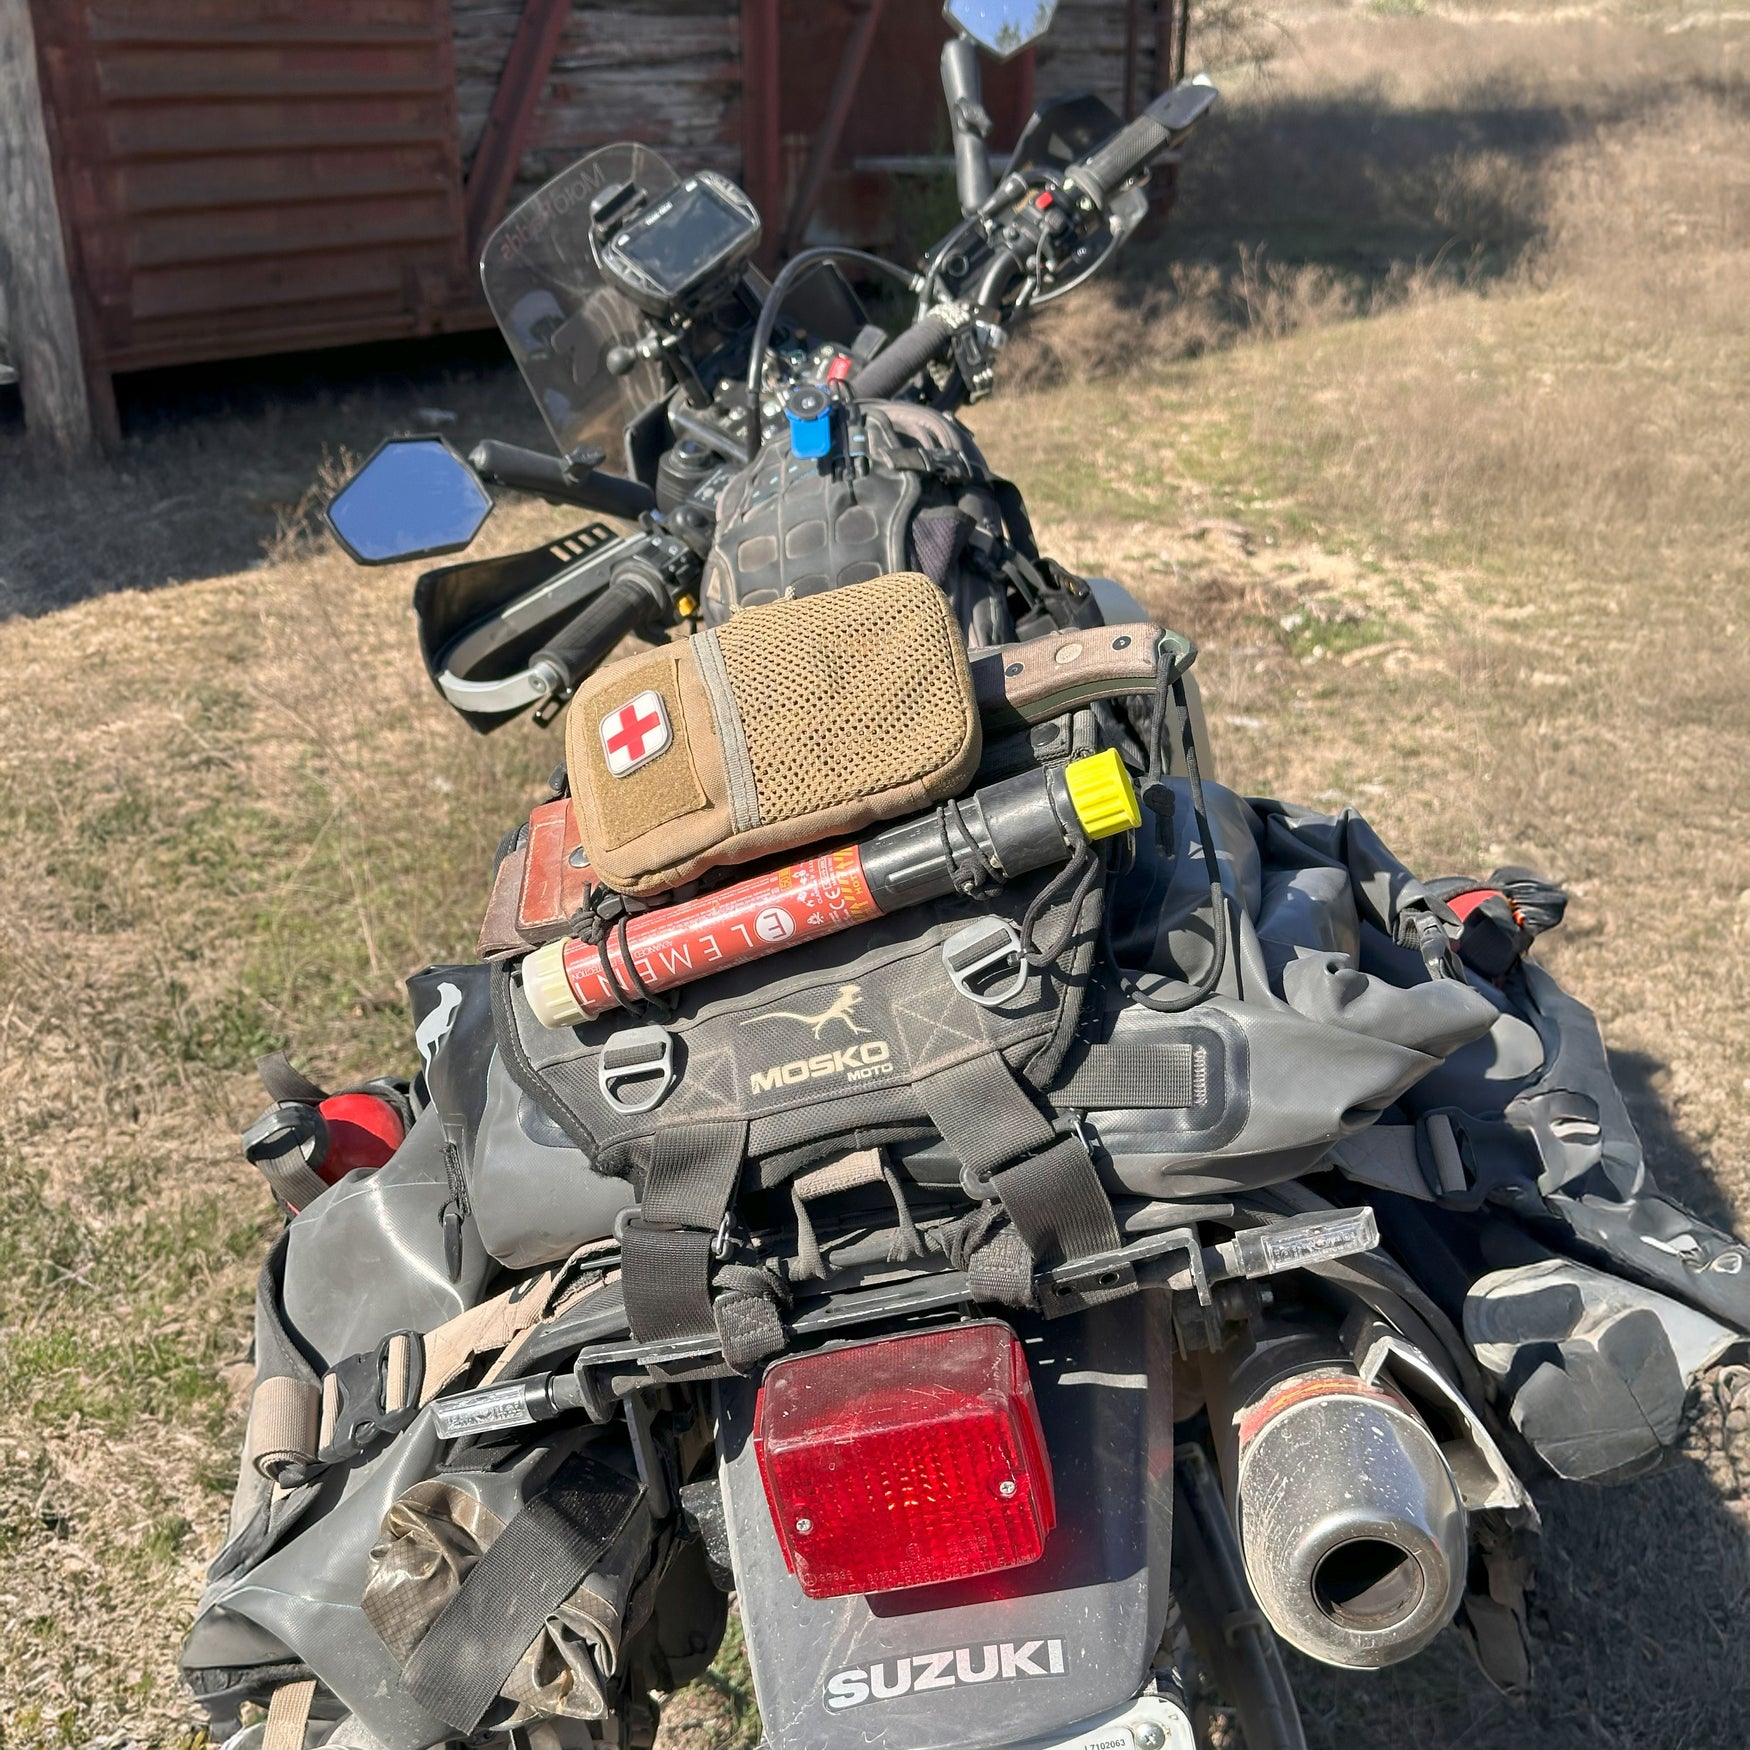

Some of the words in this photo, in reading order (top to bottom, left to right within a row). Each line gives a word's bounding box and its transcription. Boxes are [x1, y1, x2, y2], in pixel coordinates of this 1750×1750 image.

[850, 874, 863, 895] HOT
[750, 1041, 890, 1095] MOSKO
[847, 1062, 894, 1082] MOTO
[828, 1639, 1065, 1709] SUZUKI
